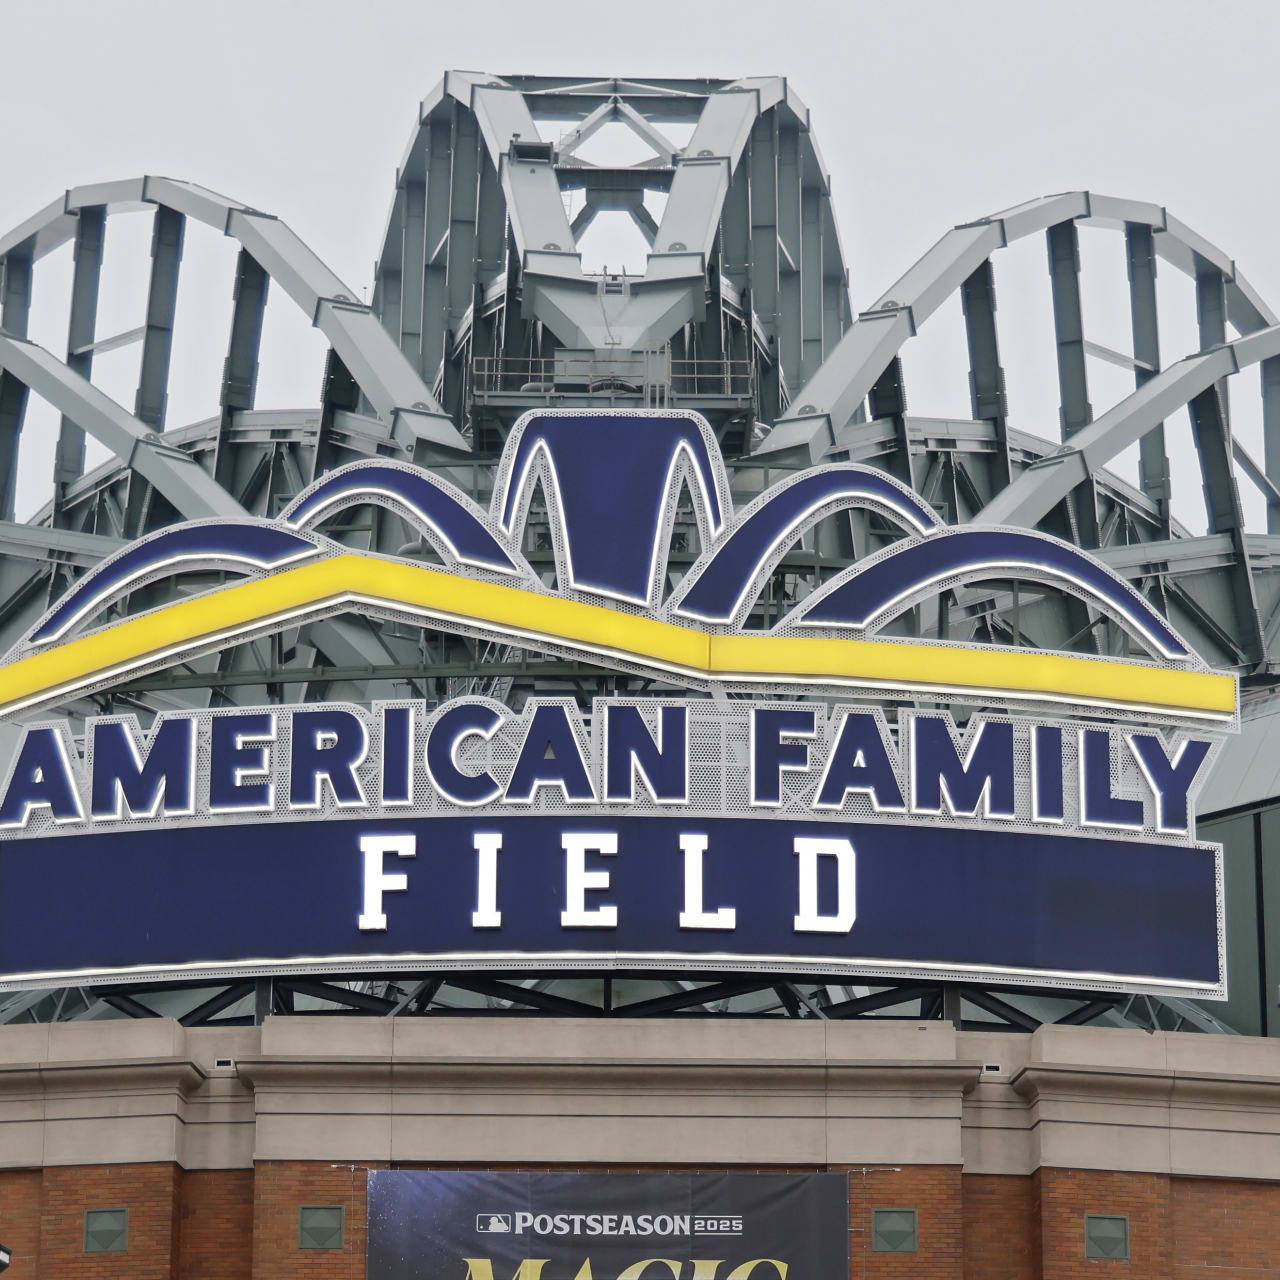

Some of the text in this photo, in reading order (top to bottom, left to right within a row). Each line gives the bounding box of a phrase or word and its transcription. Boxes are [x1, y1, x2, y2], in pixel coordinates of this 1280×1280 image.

[749, 703, 1211, 836] FAMILY
[357, 833, 858, 933] FIELD
[515, 1212, 743, 1236] POSTSEASON 2025
